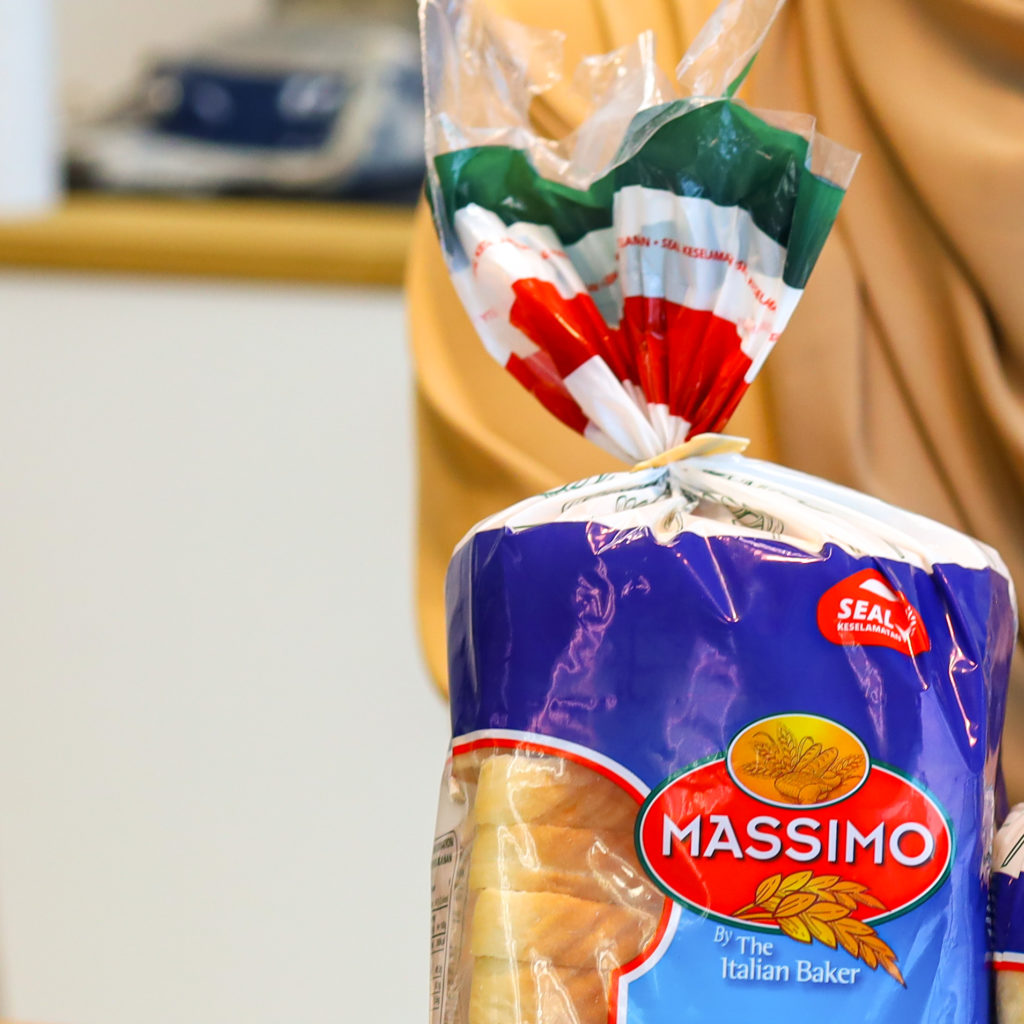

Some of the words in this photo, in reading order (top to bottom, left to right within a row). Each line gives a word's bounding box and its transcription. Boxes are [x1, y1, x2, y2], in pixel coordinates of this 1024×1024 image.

[837, 598, 895, 629] SEAL
[662, 813, 935, 867] MASSIMO
[714, 926, 733, 947] By
[736, 936, 774, 956] The
[721, 957, 790, 982] Italian
[796, 959, 861, 985] Baker
